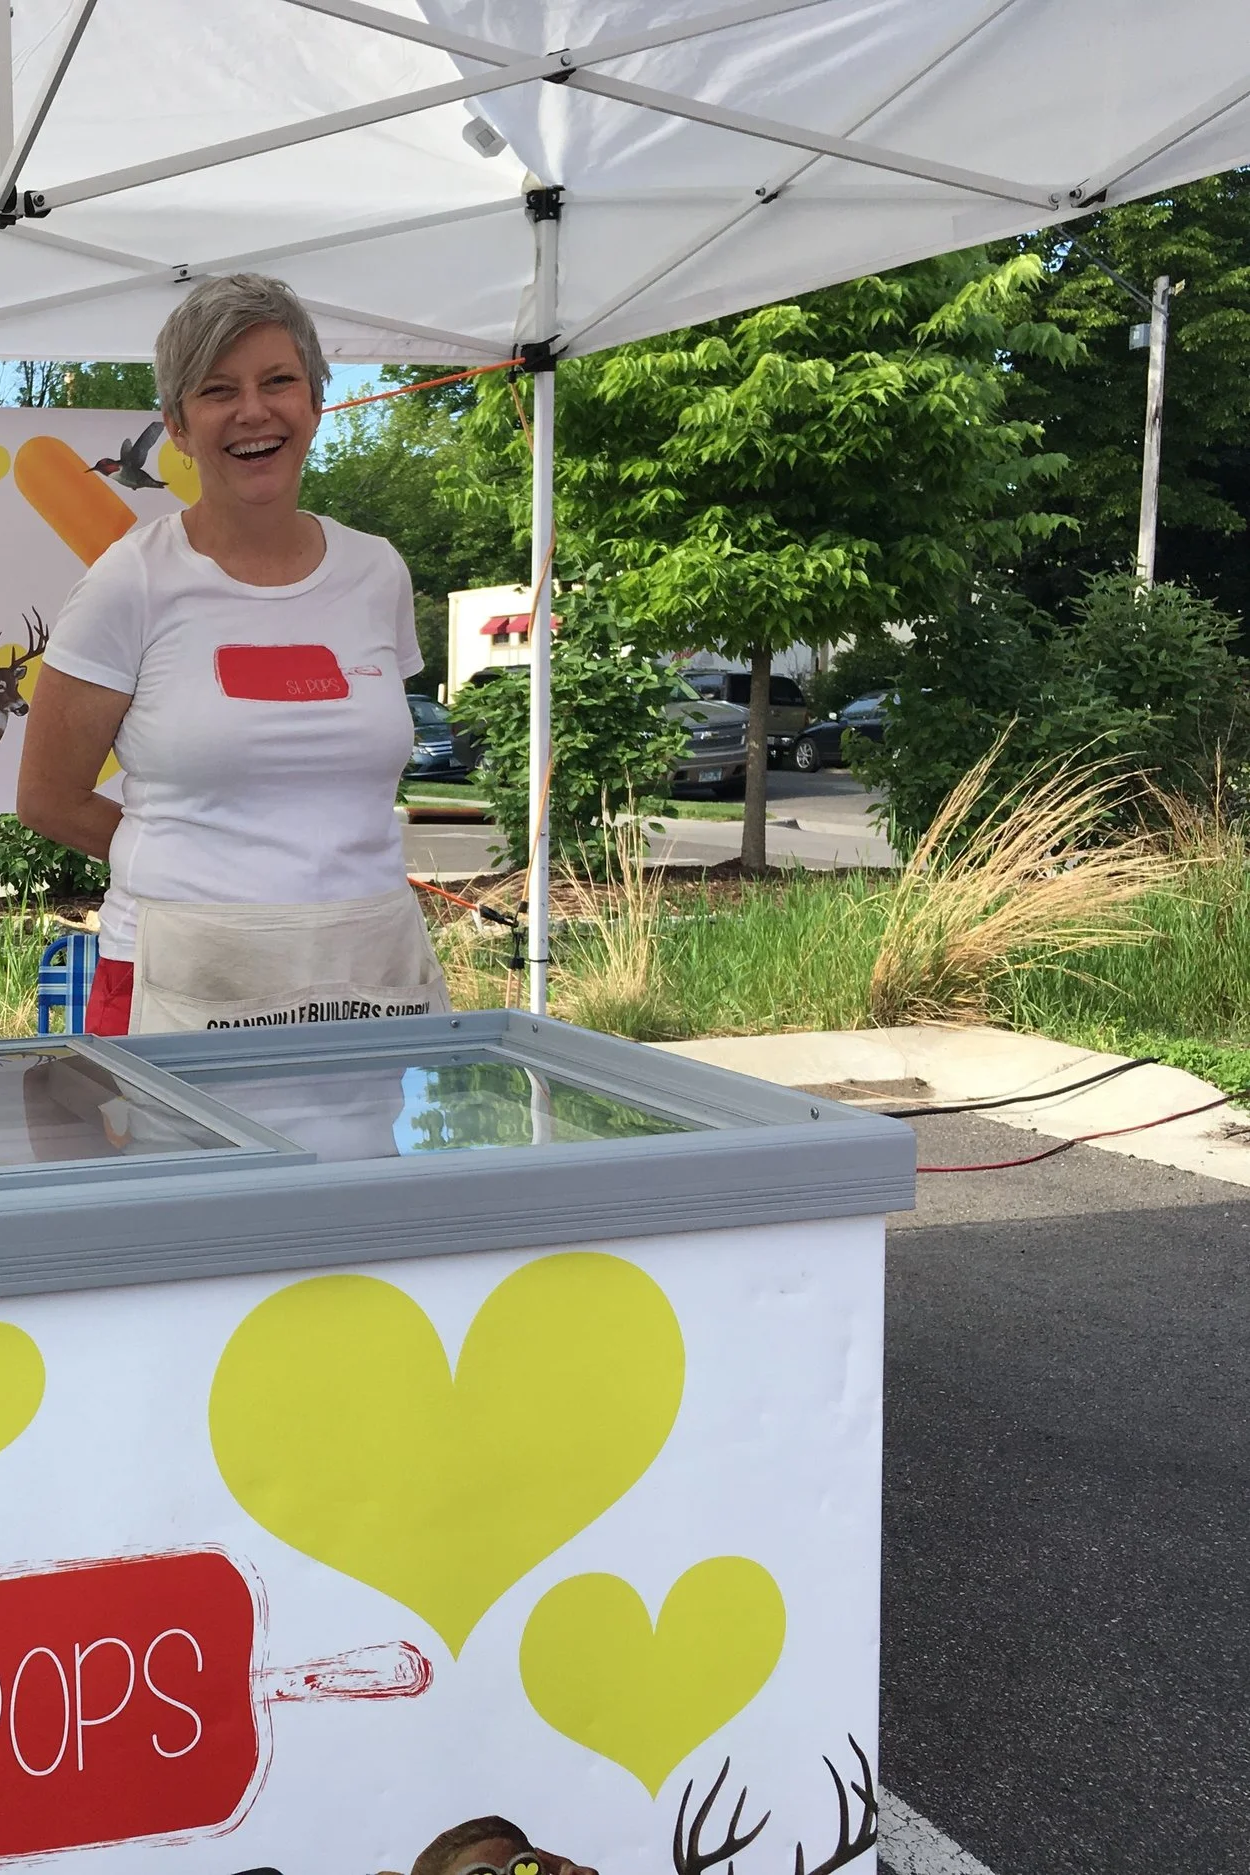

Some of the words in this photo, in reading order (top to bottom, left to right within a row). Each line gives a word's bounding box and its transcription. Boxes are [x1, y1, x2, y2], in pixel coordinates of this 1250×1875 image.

[285, 679, 304, 695] St.
[306, 677, 341, 695] POPS
[307, 1000, 382, 1023] BUILDERS
